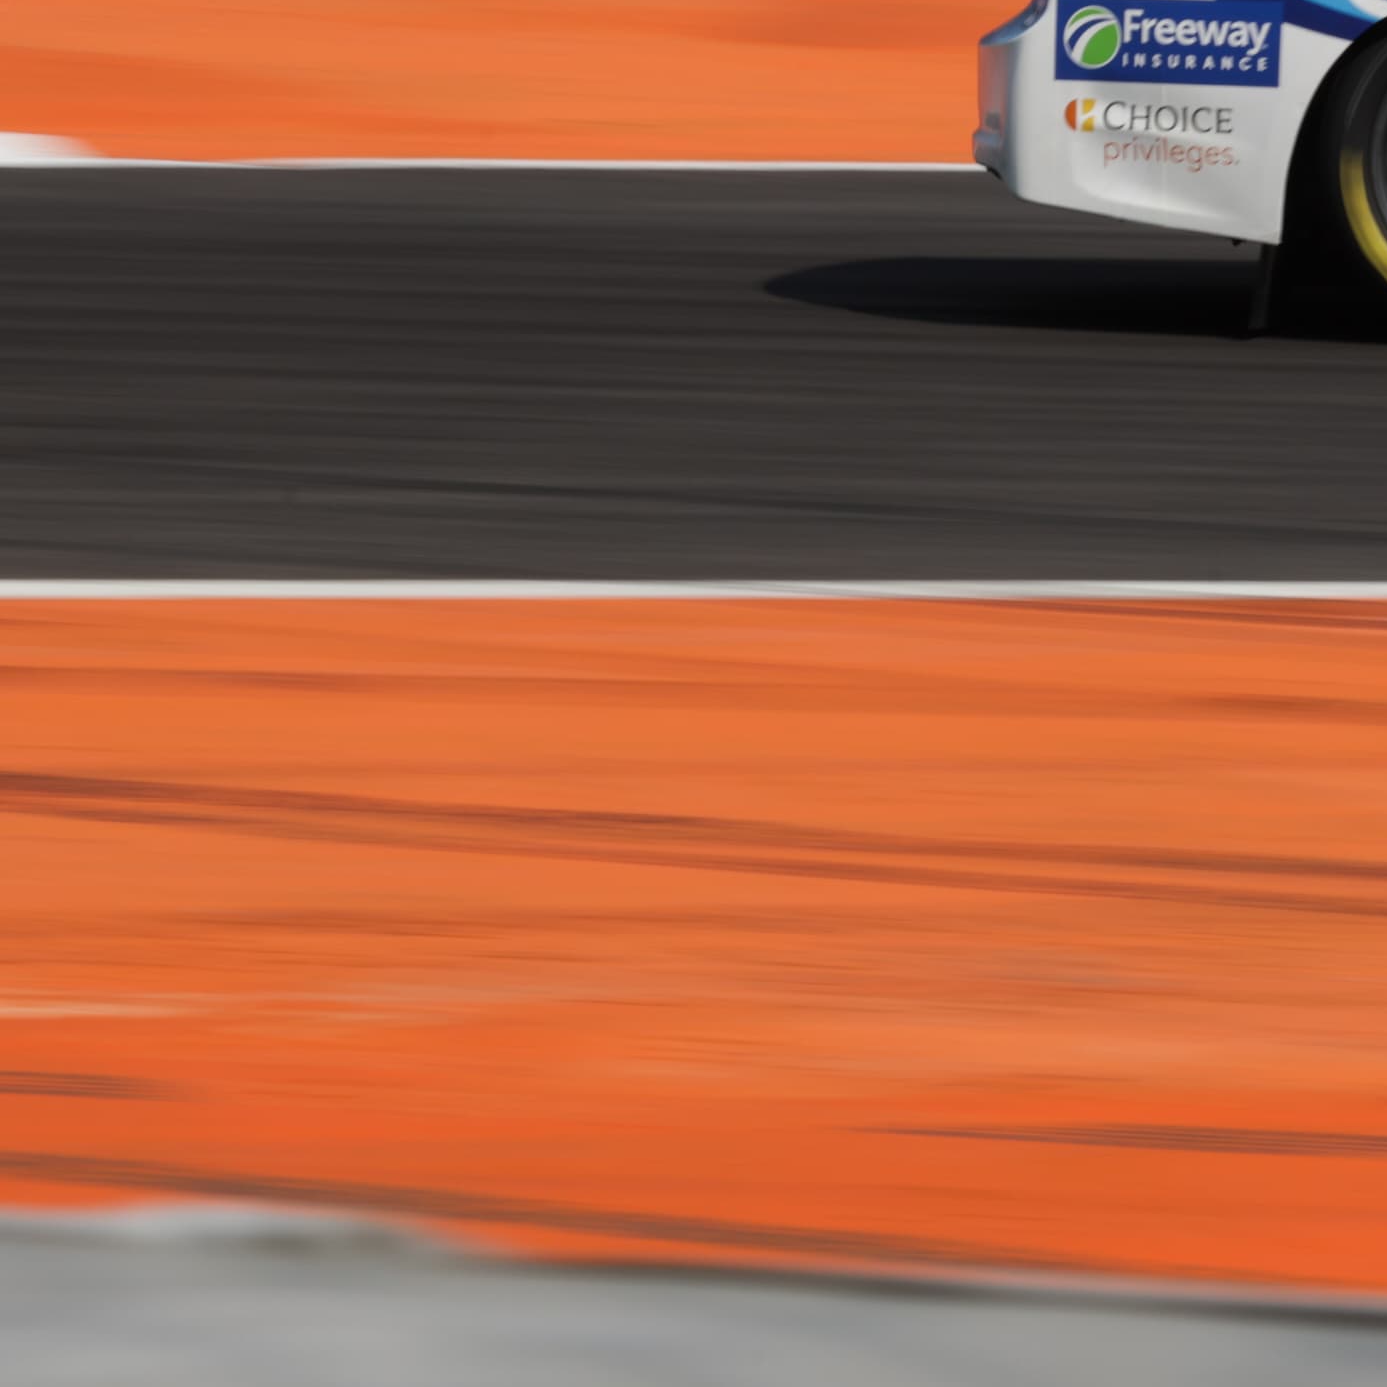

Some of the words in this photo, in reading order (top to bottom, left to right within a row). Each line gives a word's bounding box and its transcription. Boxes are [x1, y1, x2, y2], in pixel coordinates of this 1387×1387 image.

[1122, 8, 1272, 56] Freeway
[1121, 52, 1269, 72] INSURANCE
[1103, 100, 1234, 135] CHOICE
